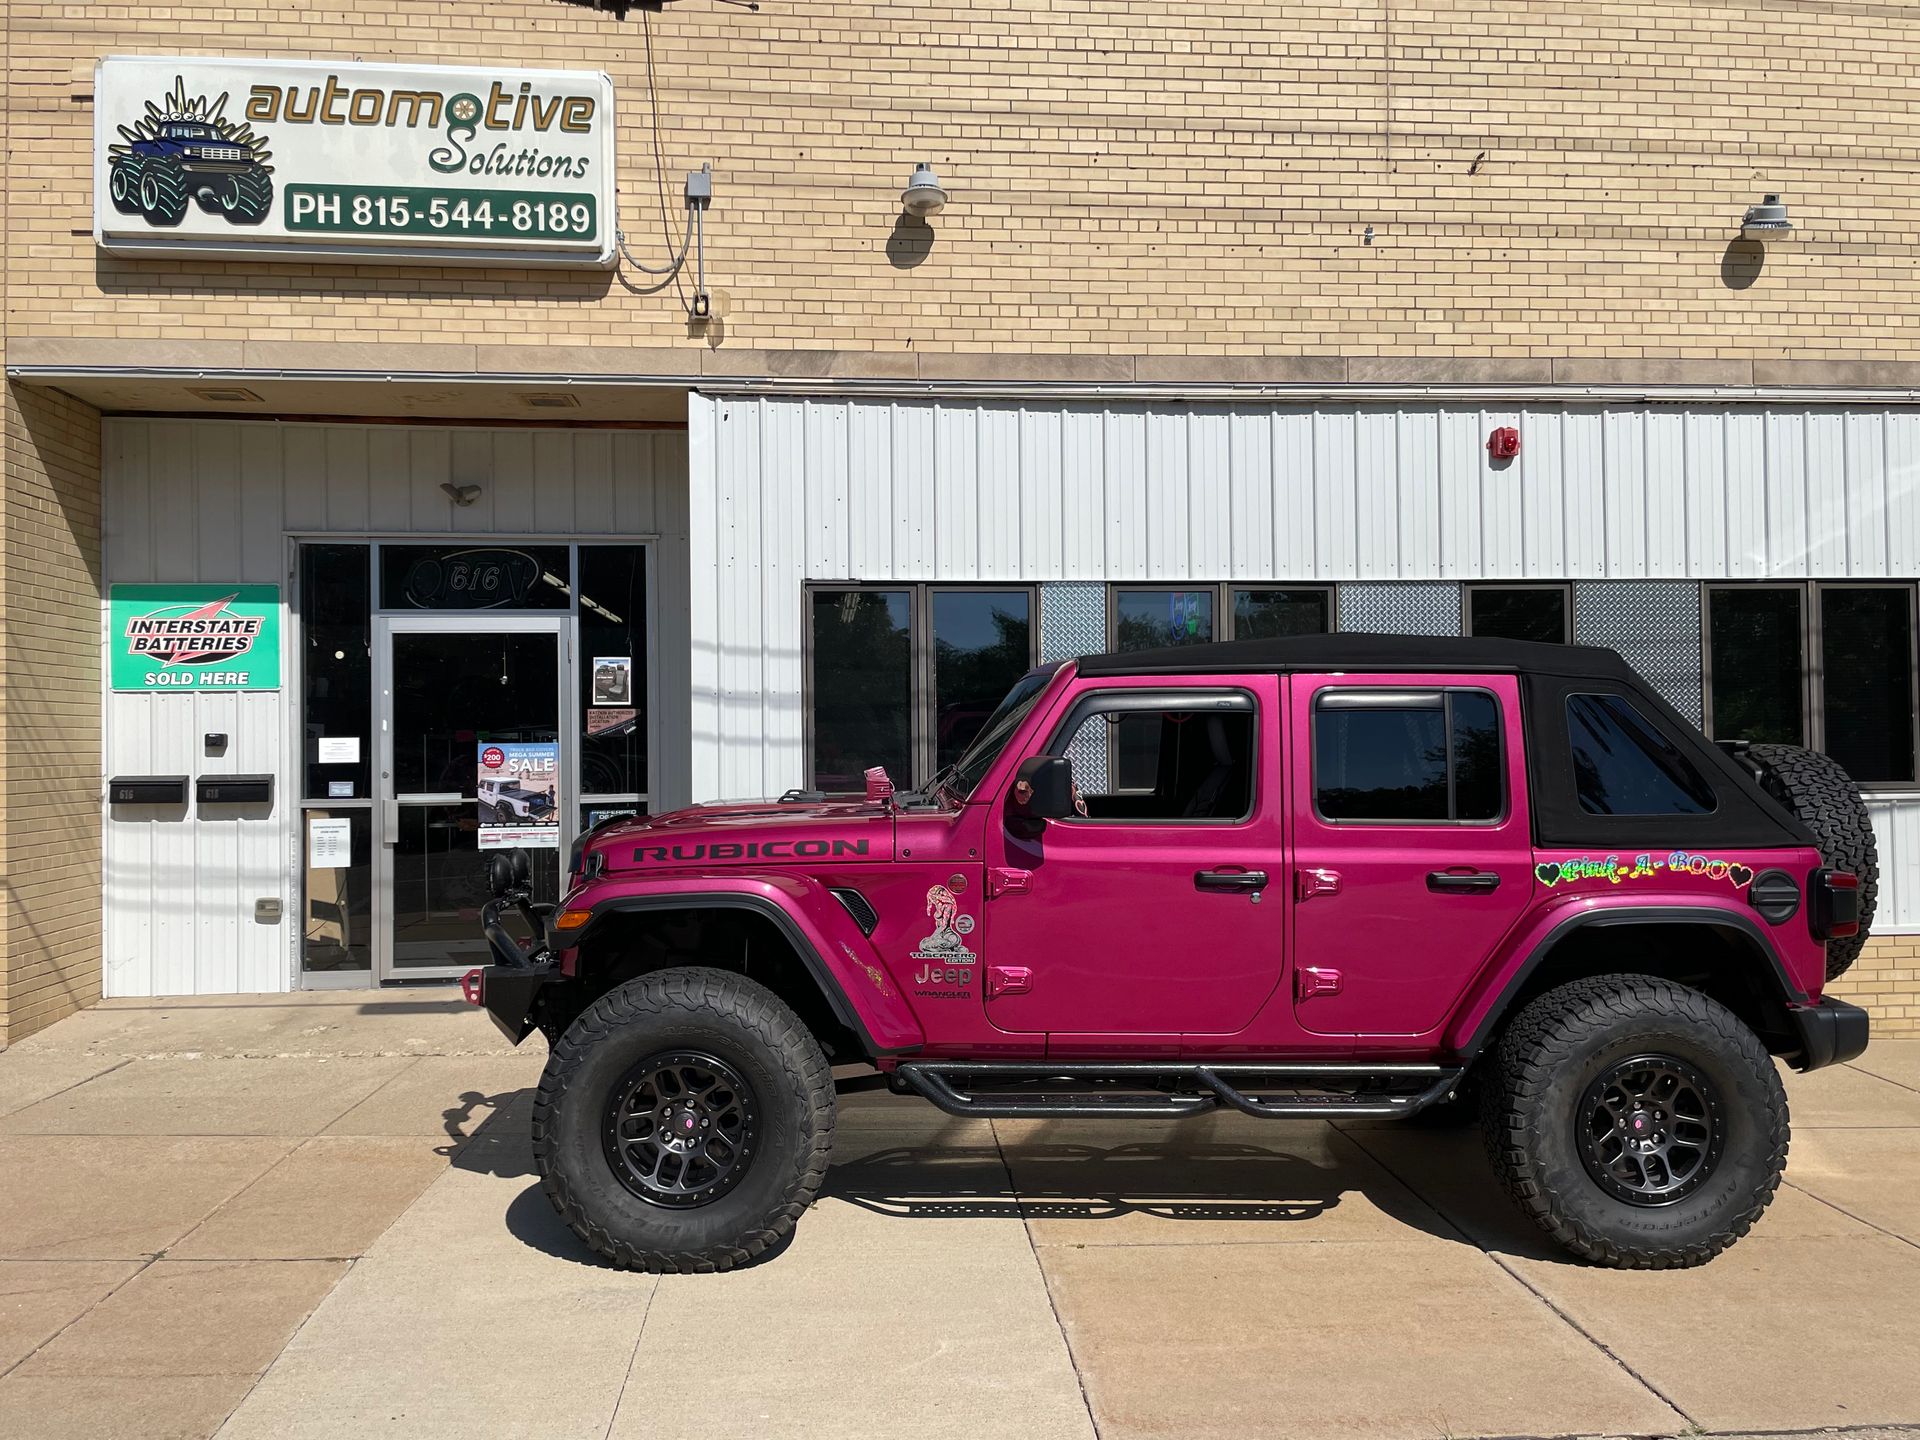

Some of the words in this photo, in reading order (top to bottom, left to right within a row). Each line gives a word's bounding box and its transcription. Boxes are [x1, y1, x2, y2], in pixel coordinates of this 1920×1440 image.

[245, 74, 594, 133] automotive
[428, 125, 590, 179] Solutions
[291, 193, 341, 225] PH
[352, 195, 591, 234] 815-544-8189
[450, 566, 500, 591] 616
[129, 618, 259, 635] INTERSTATE
[133, 636, 250, 652] BATTERIES
[144, 671, 194, 686] SOLD
[199, 672, 250, 686] HERE
[508, 758, 555, 772] SALE
[119, 789, 134, 801] 616
[205, 789, 219, 800] 616
[632, 839, 870, 863] RUBICON
[915, 963, 972, 987] Jeep
